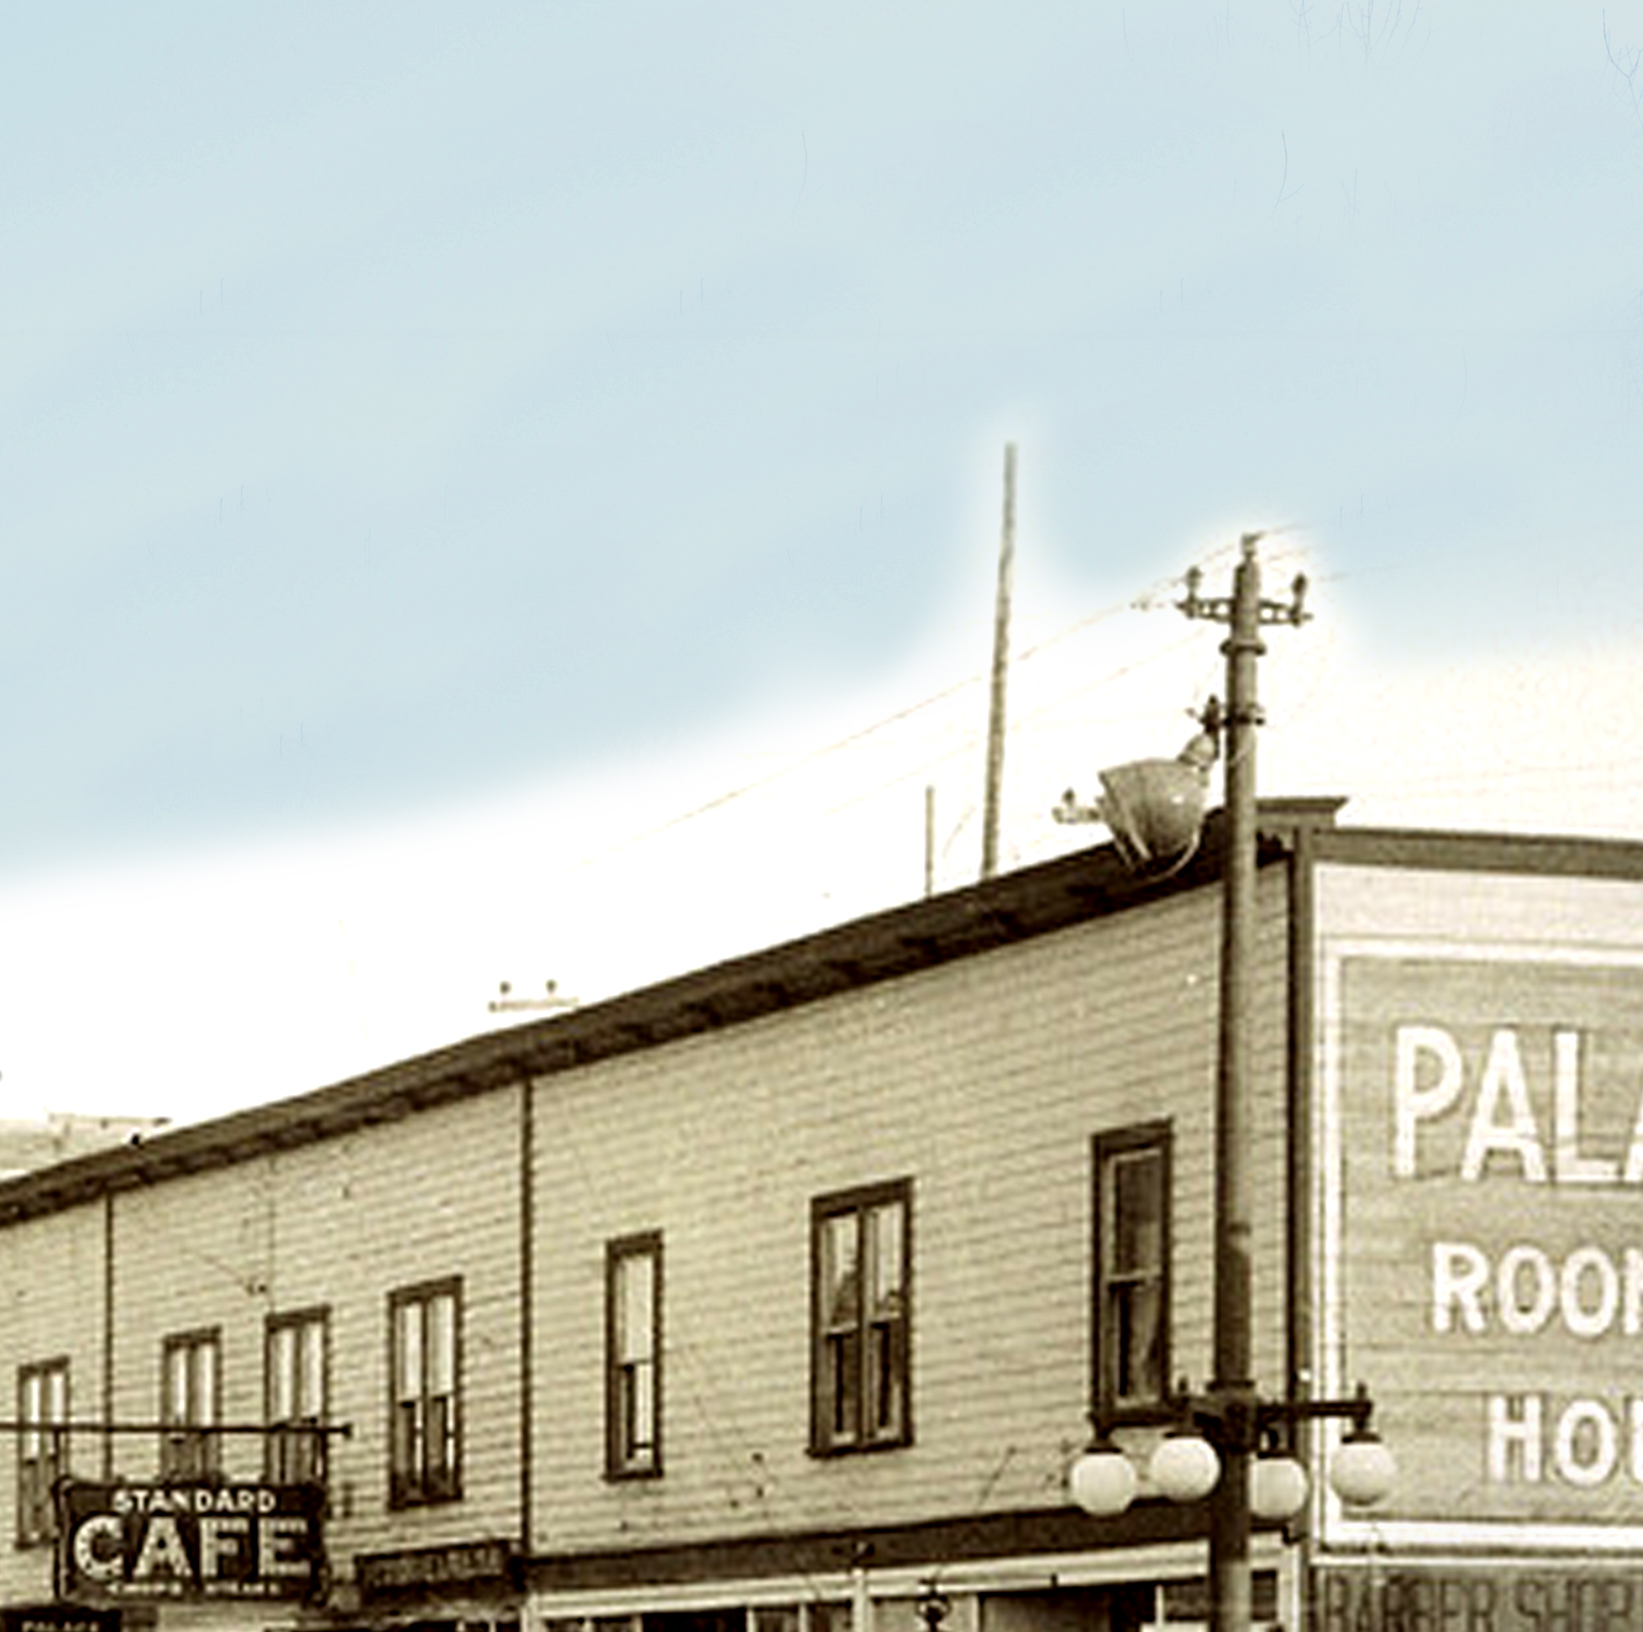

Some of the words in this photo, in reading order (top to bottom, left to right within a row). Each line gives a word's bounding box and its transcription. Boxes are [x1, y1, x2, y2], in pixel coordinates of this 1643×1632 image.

[1393, 1024, 1643, 1183] PAL
[1488, 1396, 1643, 1486] HO
[113, 1489, 277, 1513] STANDARD
[73, 1515, 312, 1581] CAFE
